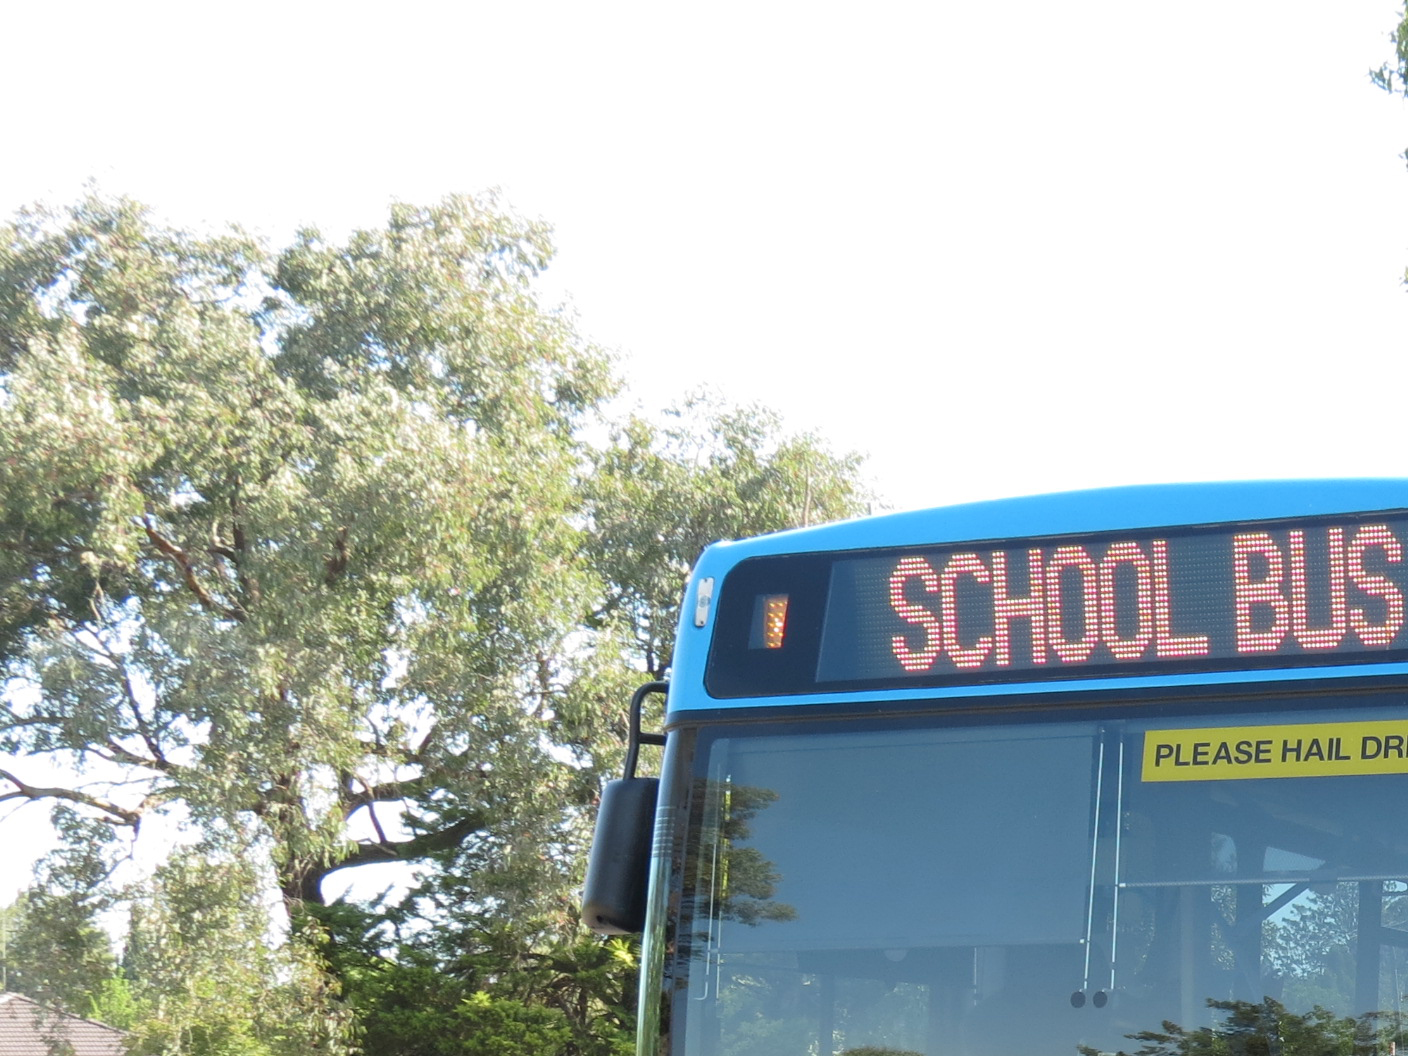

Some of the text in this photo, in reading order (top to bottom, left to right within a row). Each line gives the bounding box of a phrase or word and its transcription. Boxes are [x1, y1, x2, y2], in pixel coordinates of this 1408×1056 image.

[889, 524, 1405, 672] SCHOOL BUS
[1155, 739, 1273, 767] PLEASE
[1281, 736, 1351, 763] HAIL
